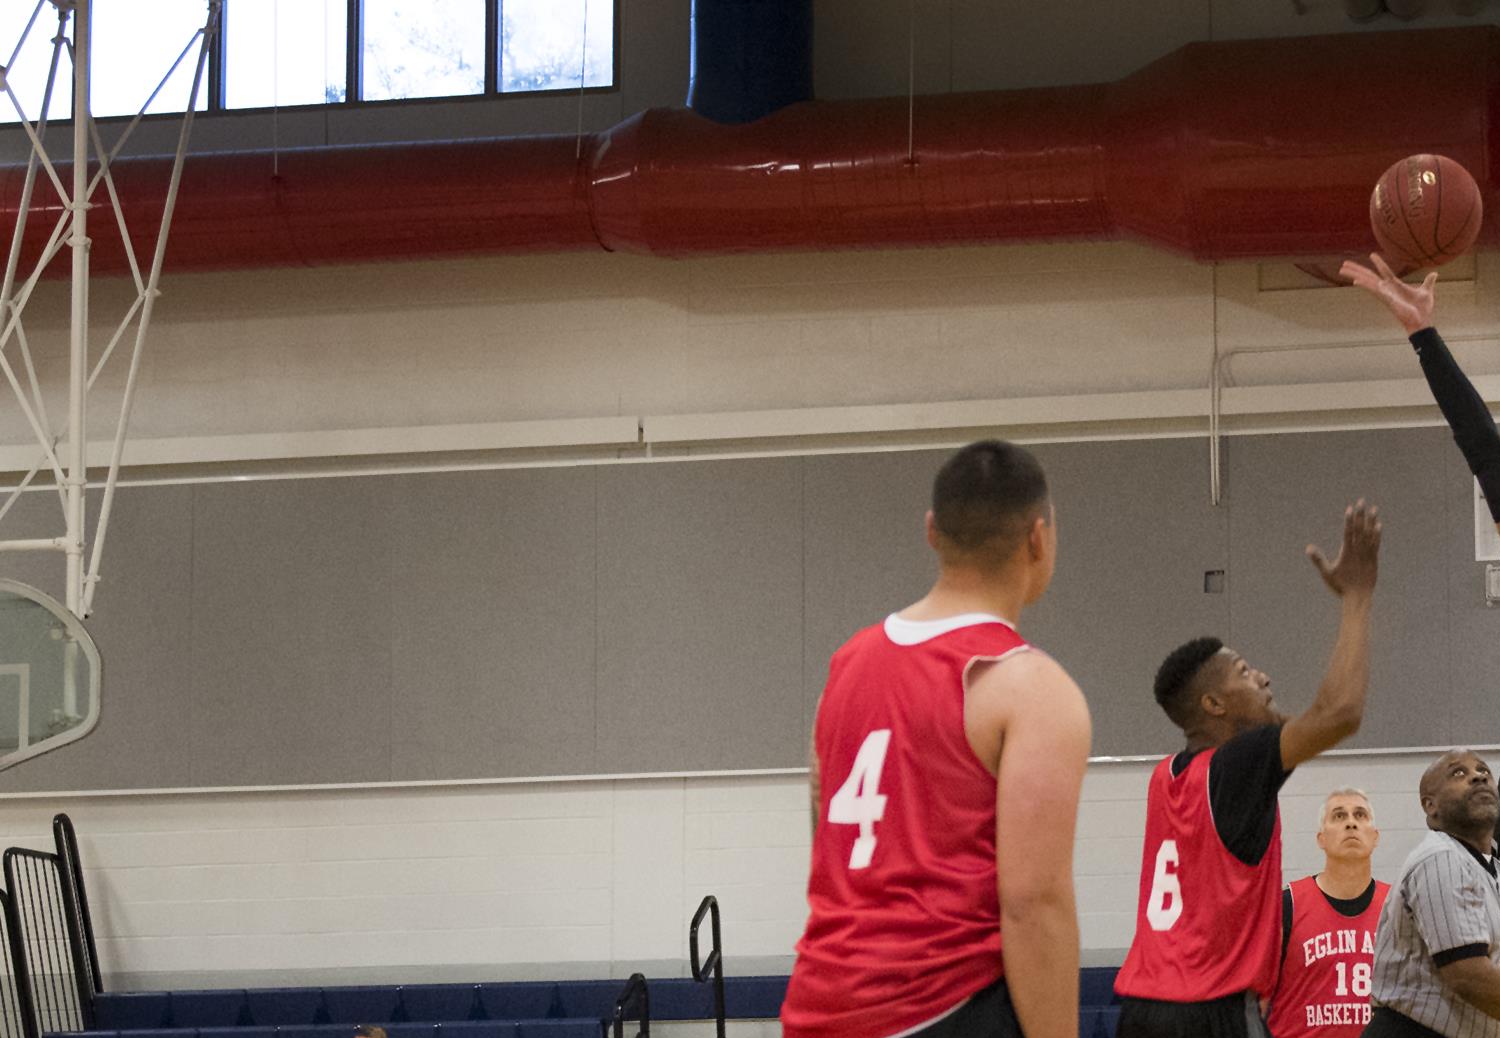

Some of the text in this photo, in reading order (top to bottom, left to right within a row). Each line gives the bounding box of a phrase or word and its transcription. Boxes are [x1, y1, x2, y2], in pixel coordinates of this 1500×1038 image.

[828, 729, 892, 870] 4
[1146, 839, 1184, 932] 6
[1302, 929, 1377, 968] EGLIN A
[1335, 962, 1372, 997] 18
[1305, 1003, 1374, 1027] BASKETB
